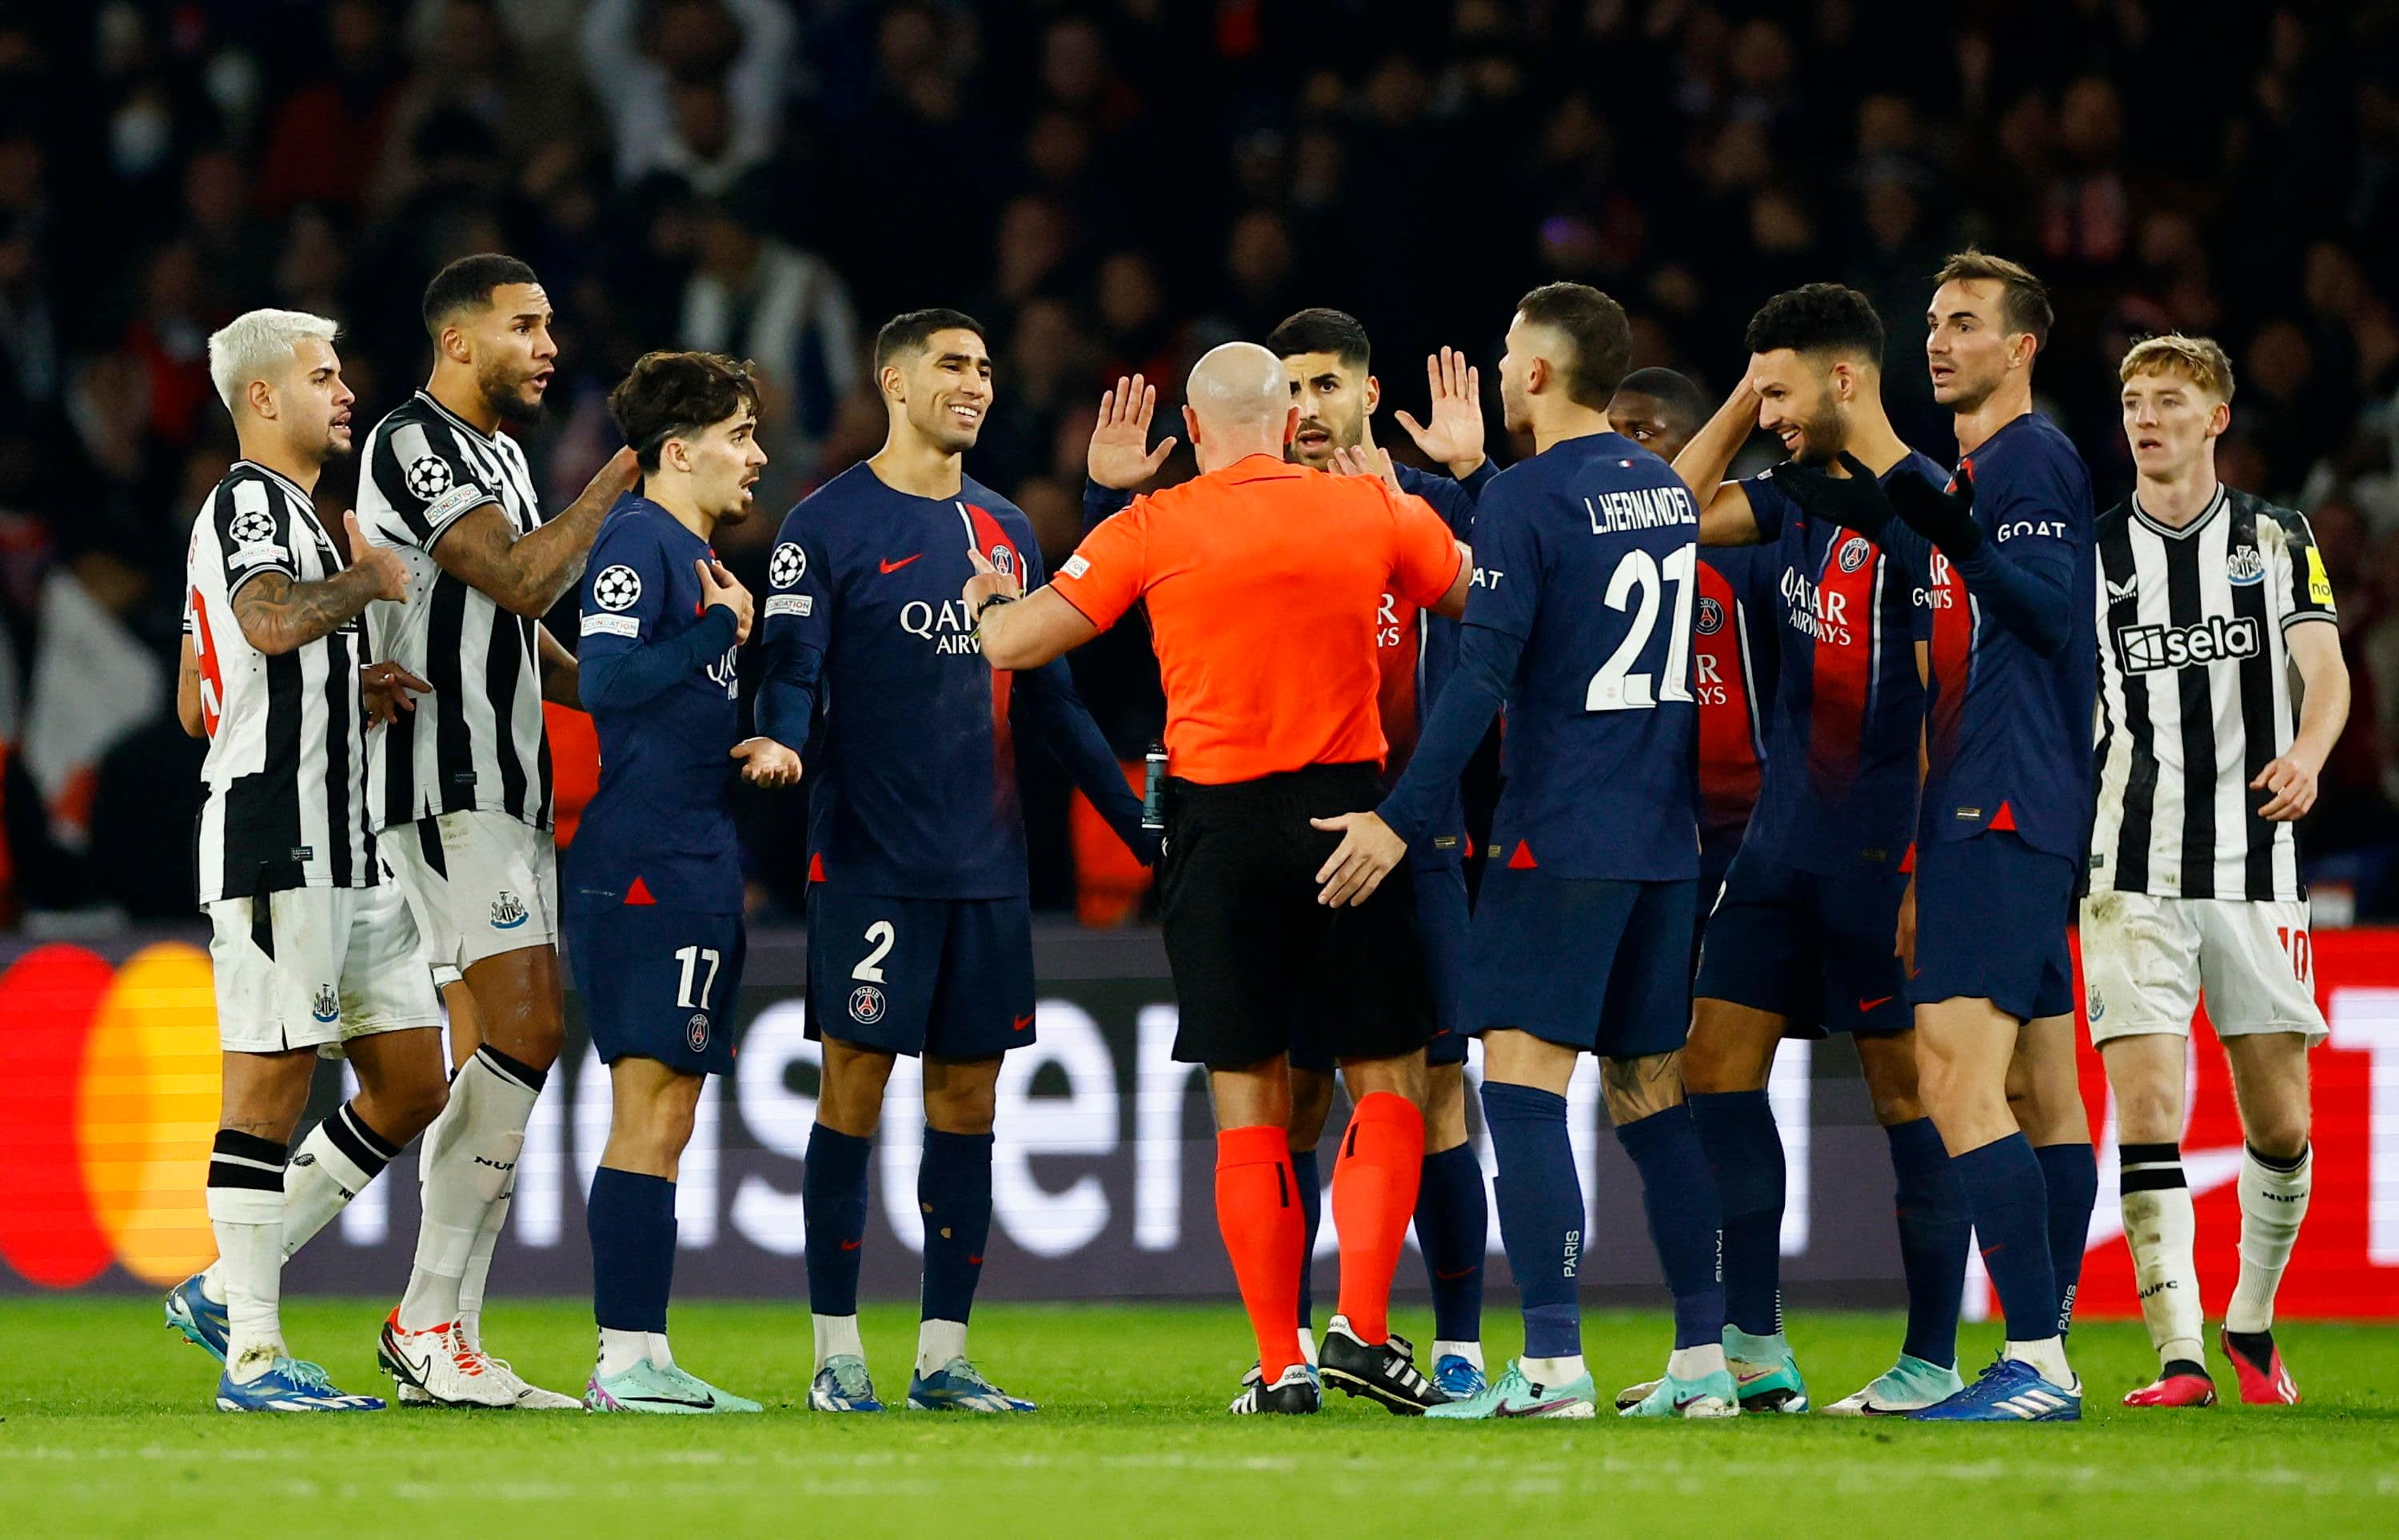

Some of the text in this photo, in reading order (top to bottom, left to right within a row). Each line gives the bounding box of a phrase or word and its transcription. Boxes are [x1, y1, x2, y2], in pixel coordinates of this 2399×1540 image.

[1998, 521, 2066, 543] GOAT
[1468, 567, 1504, 590] AT
[1781, 565, 1848, 626] QATAR
[2312, 583, 2330, 596] no
[900, 599, 972, 640] QAT
[1585, 542, 1696, 711] 21
[1788, 607, 1852, 646] AIRWAYS
[2166, 618, 2254, 664] sela
[852, 920, 895, 984] 2
[675, 945, 720, 1011] 17
[856, 987, 880, 999] PARIS
[1563, 1230, 1579, 1278] PARIS
[2058, 1284, 2077, 1331] PARIS
